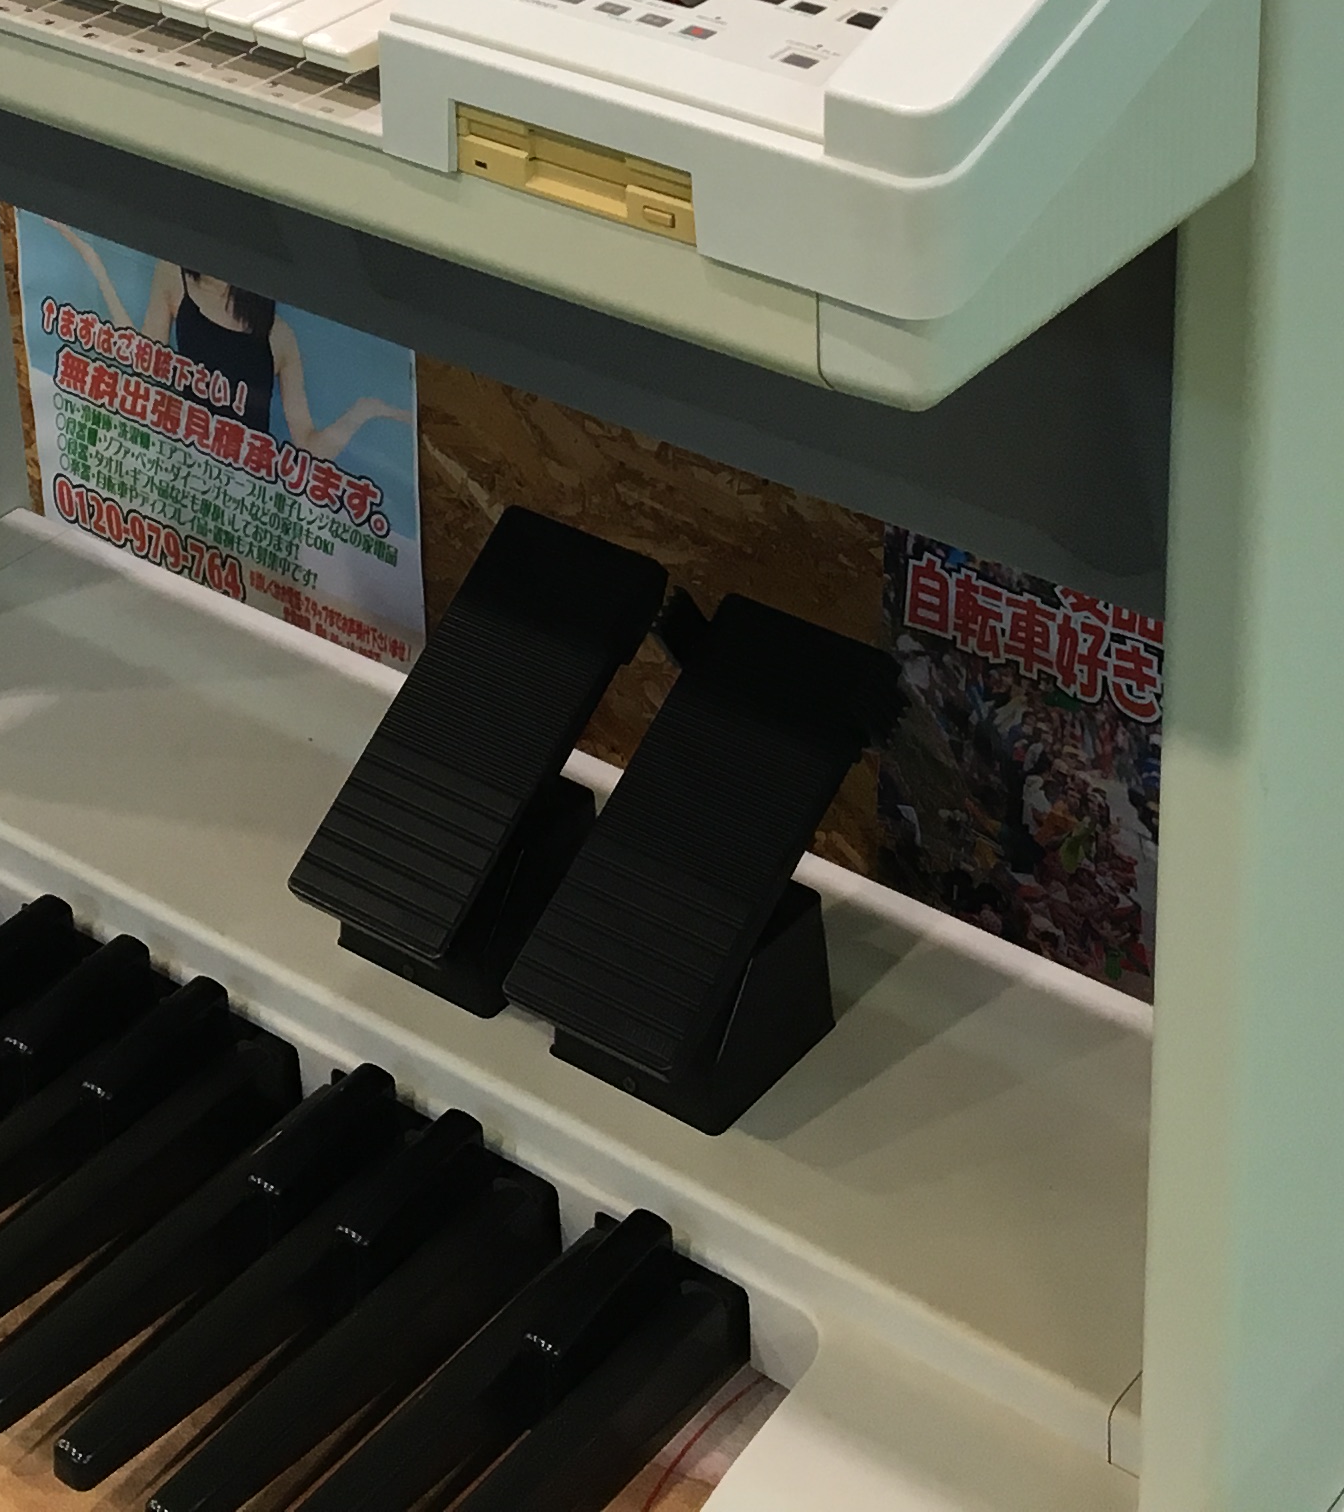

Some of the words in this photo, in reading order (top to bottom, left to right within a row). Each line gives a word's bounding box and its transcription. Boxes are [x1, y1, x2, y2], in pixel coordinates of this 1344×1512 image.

[57, 304, 248, 415] まずはご相談下さい!
[57, 349, 389, 535] 無料出張見積承ります。
[57, 479, 243, 599] 0120-979-764
[906, 554, 1162, 722] 自転車好き
